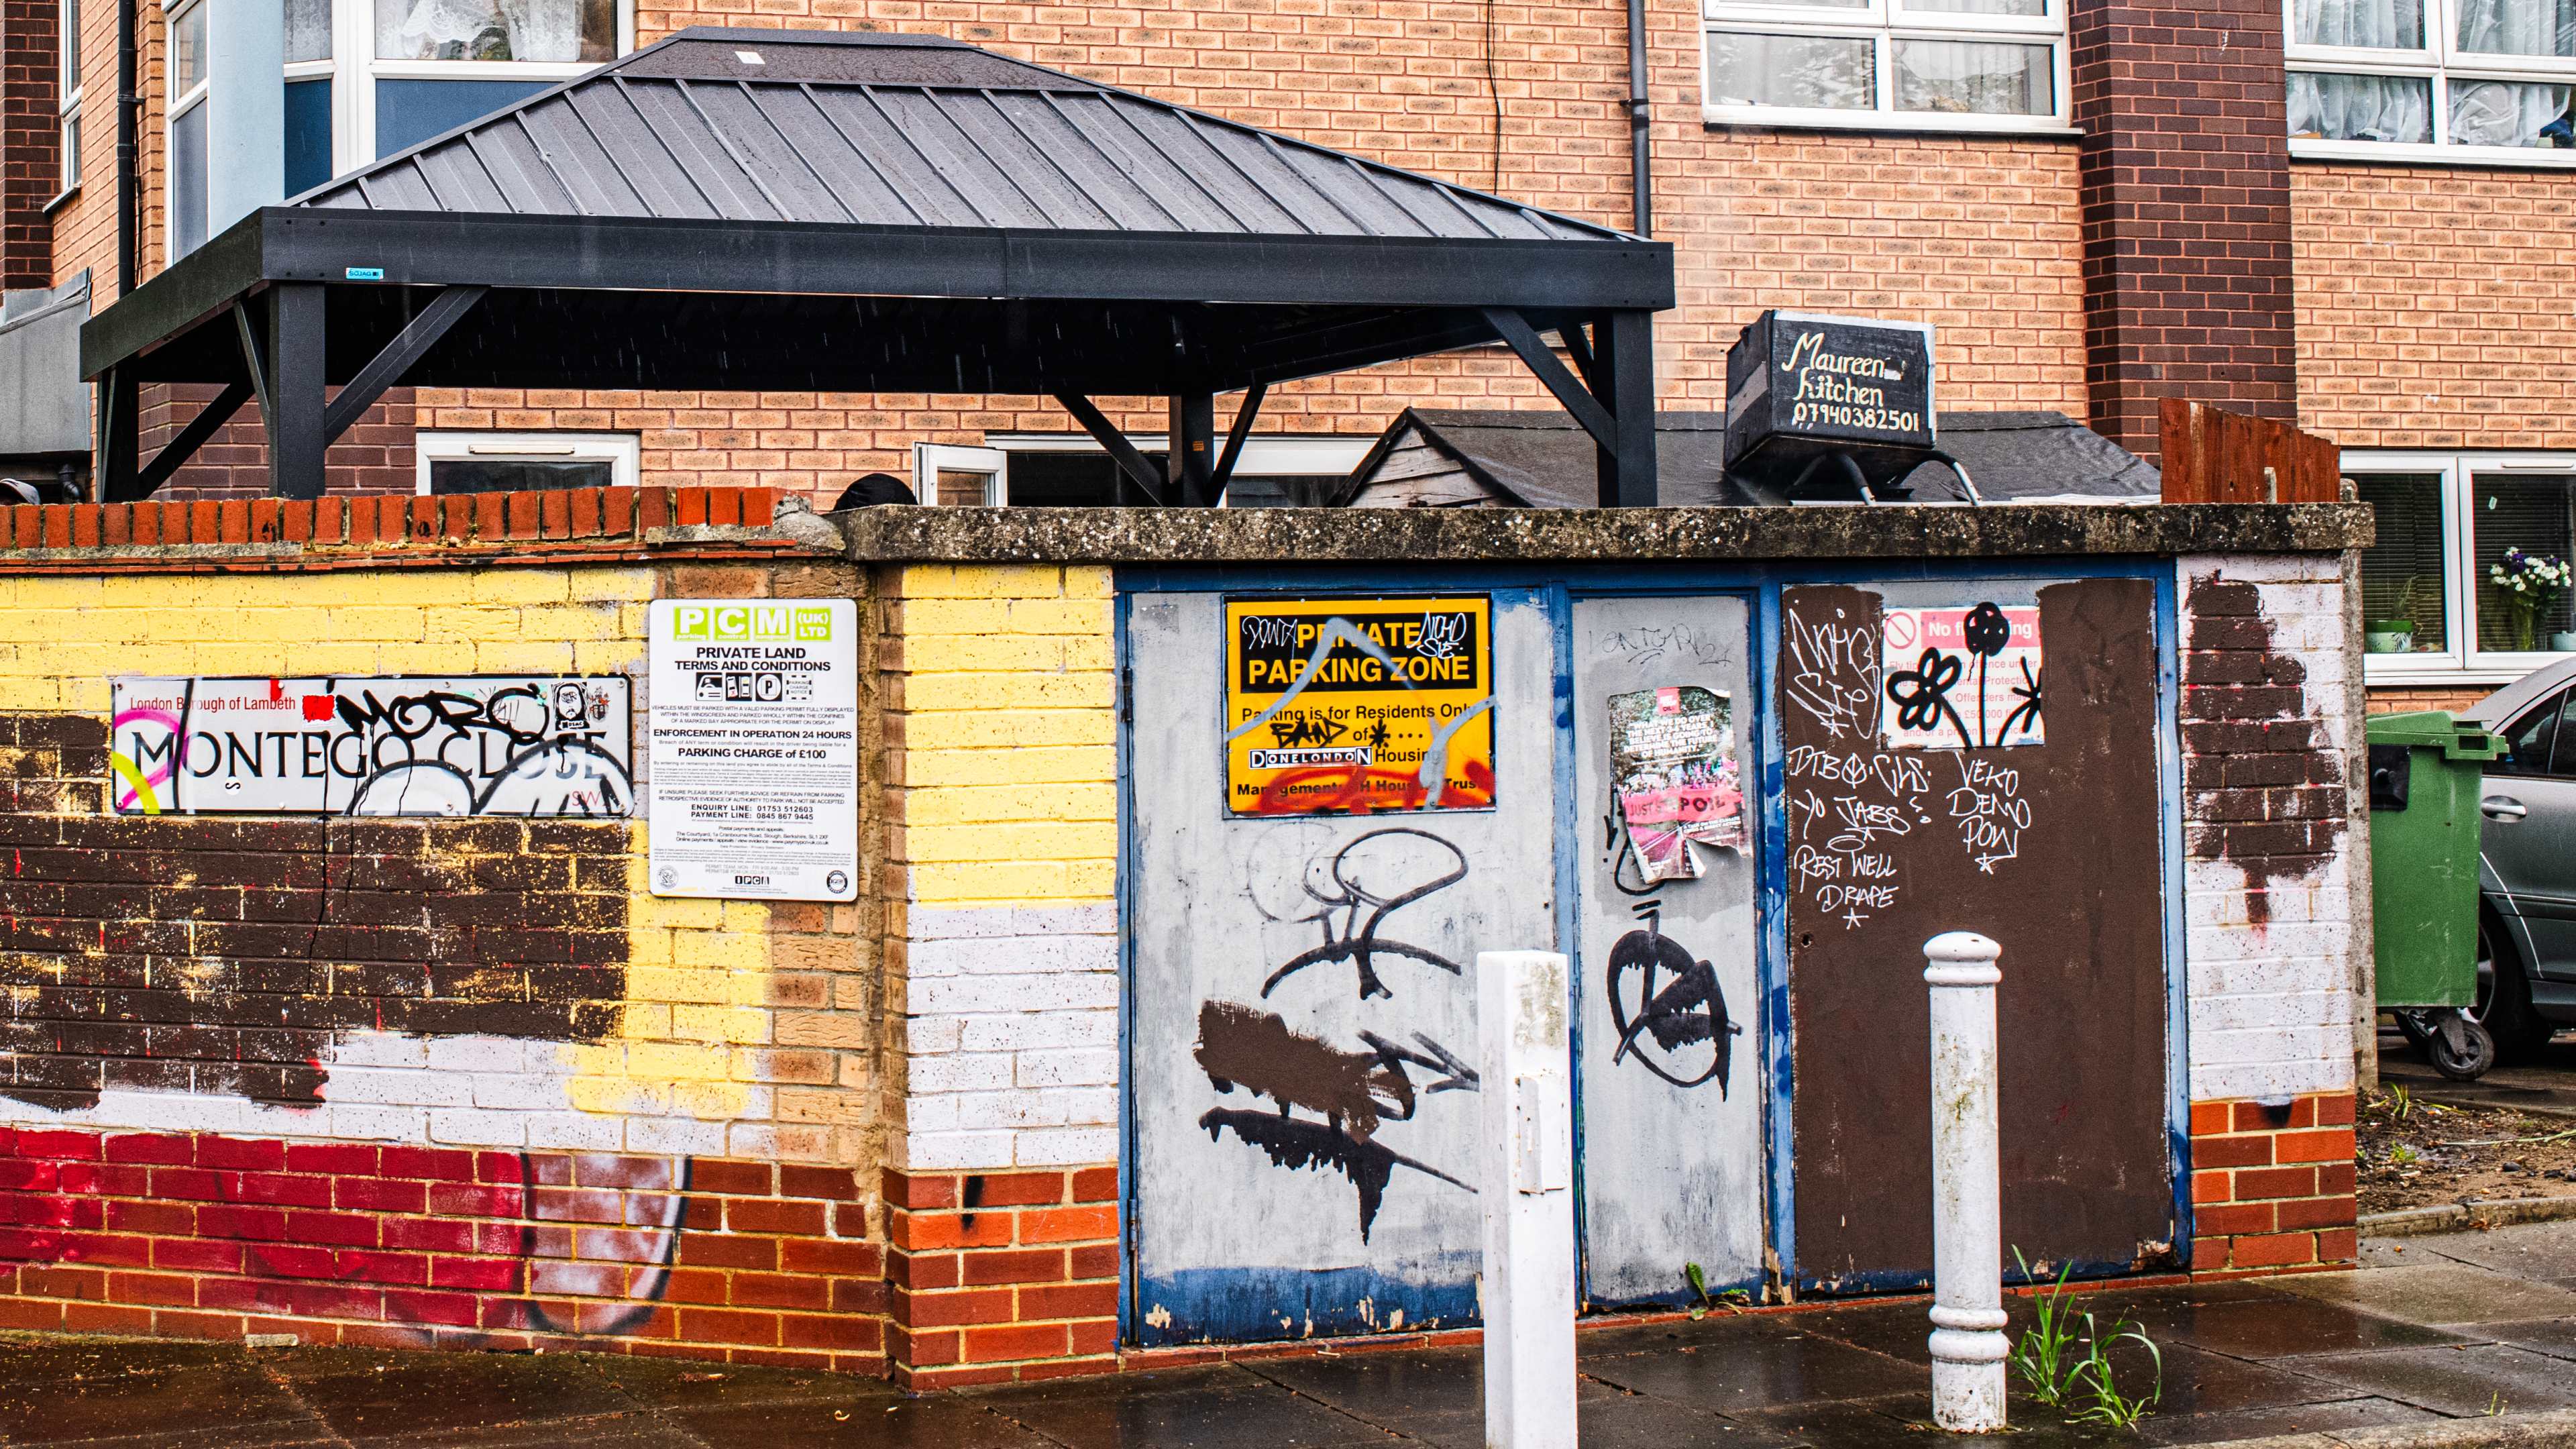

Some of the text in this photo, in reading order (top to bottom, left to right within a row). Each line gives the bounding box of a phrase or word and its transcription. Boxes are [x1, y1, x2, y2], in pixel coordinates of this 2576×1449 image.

[1794, 402, 1919, 431] 07940382501
[798, 612, 828, 624] (UK)
[800, 627, 826, 637] LTD
[1929, 621, 1951, 637] No
[696, 647, 806, 658] PRIVATE LAND
[675, 661, 830, 671] TERMS AND CONDITIONS
[1249, 655, 1470, 684] PARKING ZONE
[1969, 659, 2005, 669] offnce
[1985, 676, 2031, 686] Protectio
[1955, 692, 2005, 702] Offeders
[130, 696, 296, 713] London Brough of Lambeth
[1242, 703, 1475, 722] Paking is for Residents Onl
[653, 729, 726, 737] ENFORCEMENT
[742, 730, 800, 738] OPERATION
[802, 731, 814, 739] 24
[816, 731, 851, 739] HOURS
[1353, 727, 1368, 741] of
[1626, 729, 1643, 738] THE
[131, 731, 607, 780] MONTEGO CLOSE
[678, 747, 826, 759] PARKING CHARGE of £100
[1375, 747, 1428, 763] Housin
[1794, 845, 1897, 893] REST WELL
[1817, 884, 1900, 912] DRAPE
